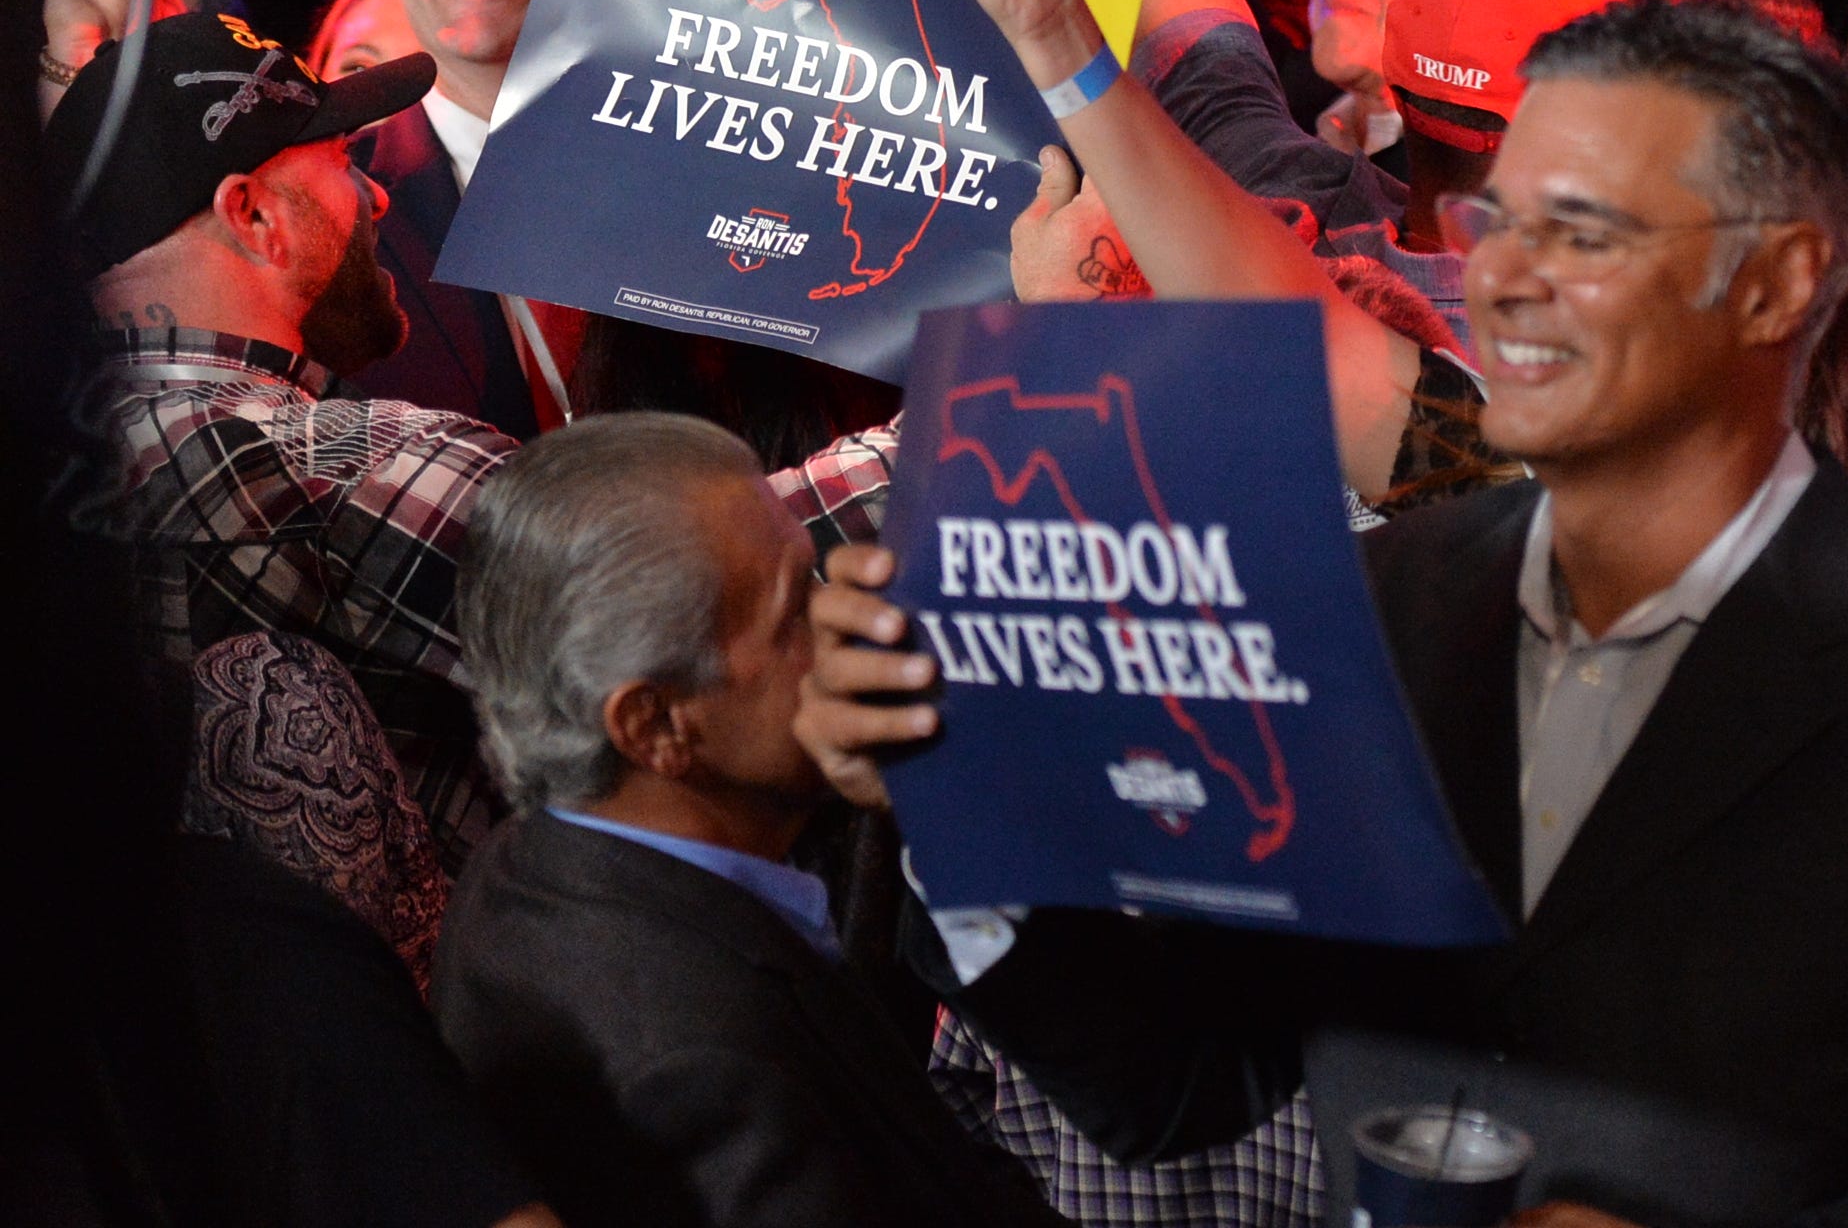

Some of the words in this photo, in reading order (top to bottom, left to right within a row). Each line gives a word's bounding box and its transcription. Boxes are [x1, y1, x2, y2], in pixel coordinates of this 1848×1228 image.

[655, 7, 990, 133] FREEDOM
[1413, 53, 1491, 90] TRUMP
[592, 71, 795, 161] LIVES
[796, 115, 999, 210] HERE.
[706, 214, 810, 256] DESANTIS
[755, 217, 776, 231] RON
[716, 242, 745, 252] FLORIDA
[748, 247, 785, 259] GOVERNOR
[623, 293, 640, 303] PAID
[641, 297, 651, 306] BY
[651, 300, 669, 310] RON
[752, 319, 768, 328] FOR
[768, 322, 811, 338] GOVERNOR
[938, 516, 1246, 607] FREEDOM
[917, 611, 1101, 694] LIVES
[1099, 617, 1310, 705] HERE.
